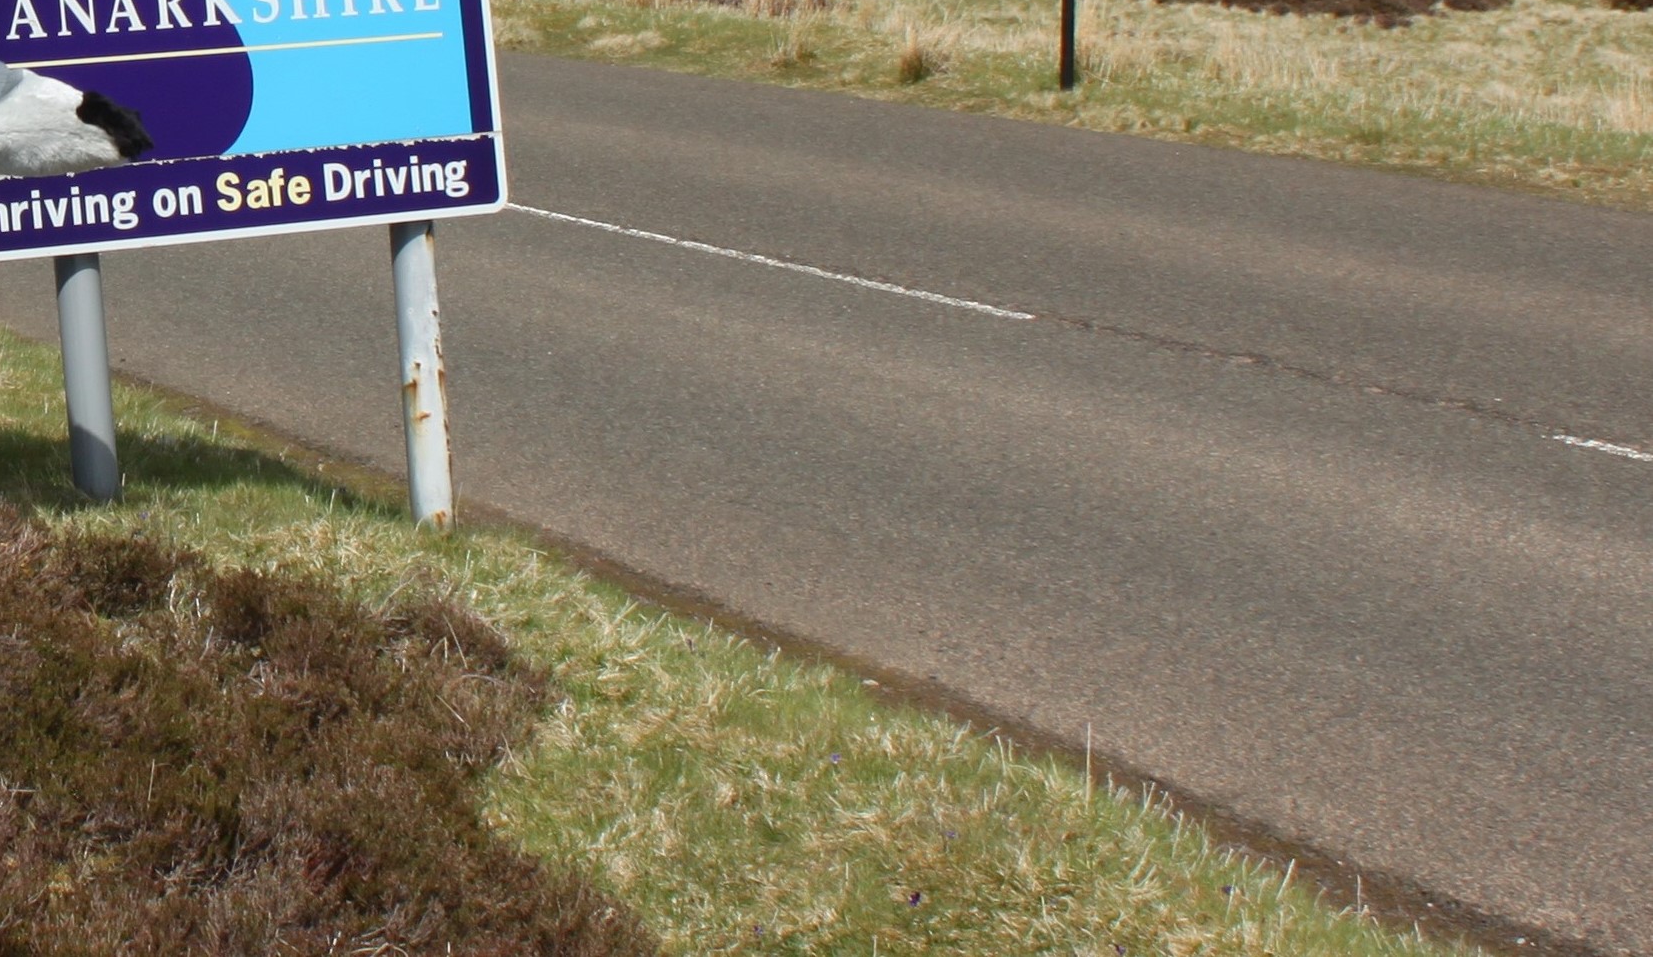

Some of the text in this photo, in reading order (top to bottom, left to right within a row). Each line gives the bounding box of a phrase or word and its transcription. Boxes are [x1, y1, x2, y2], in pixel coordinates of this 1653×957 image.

[152, 185, 203, 218] on
[216, 167, 311, 212] Safe
[323, 156, 470, 202] Driving
